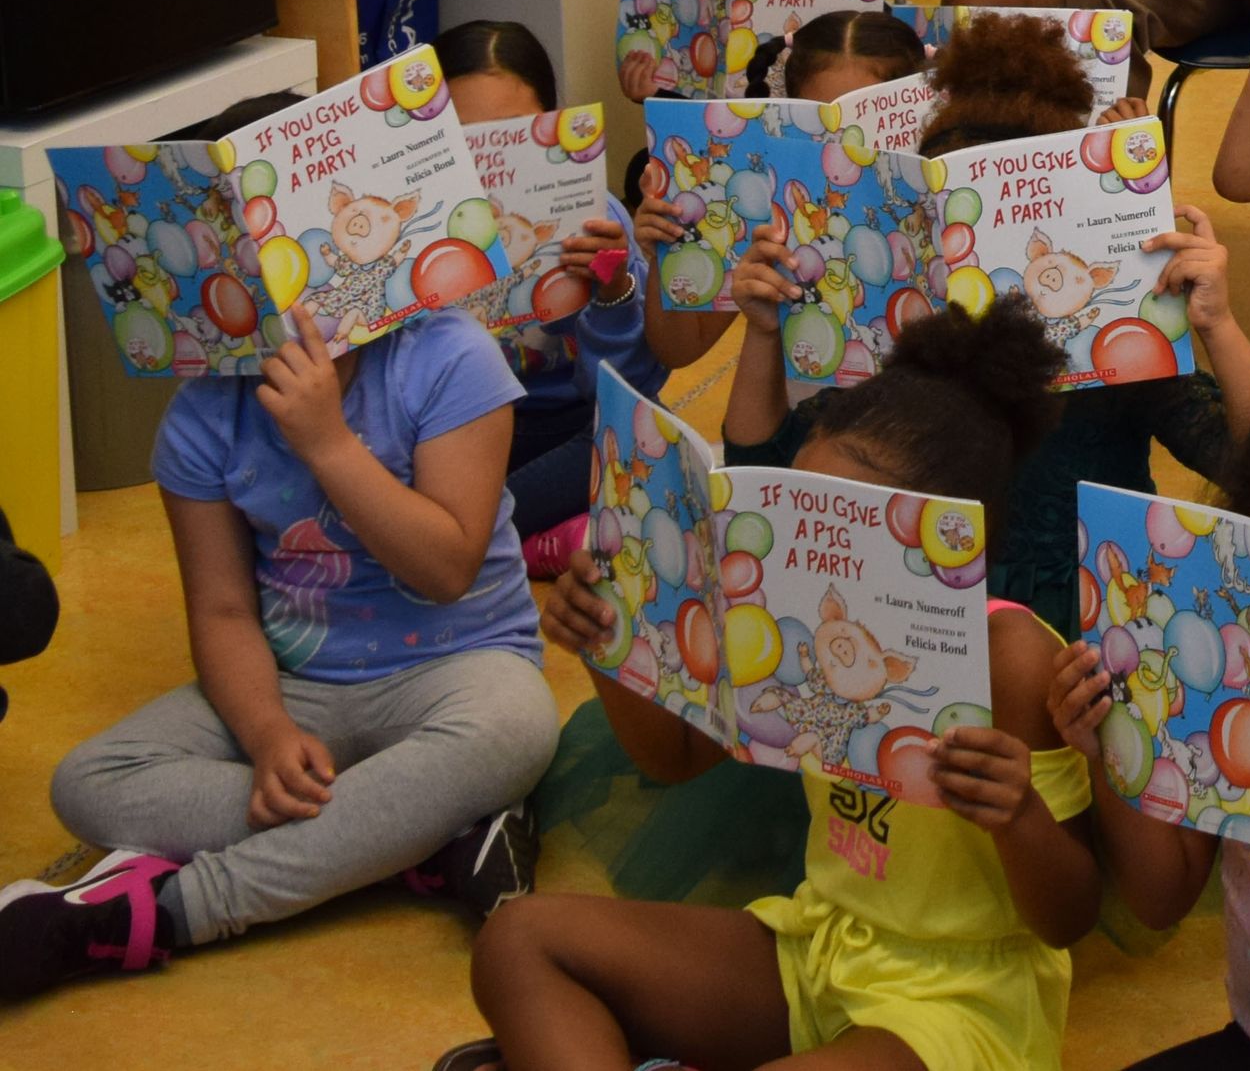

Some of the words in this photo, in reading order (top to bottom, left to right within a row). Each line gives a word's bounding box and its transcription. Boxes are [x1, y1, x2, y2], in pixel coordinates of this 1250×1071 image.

[870, 91, 898, 113] YOU
[900, 84, 936, 106] GIVE
[254, 126, 274, 154] IF
[277, 110, 314, 141] YOU
[315, 95, 361, 125] GIVE
[888, 109, 918, 131] PIG
[291, 144, 303, 165] A
[304, 128, 342, 156] PIG
[380, 148, 405, 167] Laura
[405, 128, 446, 153] Numeroff
[489, 127, 528, 147] GIVE
[289, 172, 302, 194] A
[305, 144, 357, 184] PARTY
[405, 167, 432, 187] Felicia
[433, 157, 456, 174] Bond
[474, 151, 505, 170] PIG
[968, 159, 988, 182] IF
[992, 153, 1028, 177] YOU
[1032, 149, 1077, 173] GIVE
[1000, 182, 1012, 202] A
[1016, 177, 1053, 199] PIG
[992, 208, 1005, 229] A
[1011, 197, 1065, 225] PARTY
[1087, 215, 1113, 227] Laura
[1114, 206, 1157, 224] Numeroff
[1107, 243, 1136, 255] Felicia
[376, 293, 439, 326] SCHOLASTIC
[759, 483, 782, 509] IF
[788, 488, 829, 515] YOU
[833, 495, 882, 527] GIVE
[794, 522, 808, 541] A
[814, 522, 852, 550] PIG
[785, 550, 798, 571] A
[806, 550, 864, 582] PARTY
[885, 593, 914, 611] Laura
[916, 600, 966, 619] Numeroff
[904, 634, 939, 653] Felicia
[940, 640, 968, 657] Bond
[832, 765, 903, 792] SCHOLASTIC
